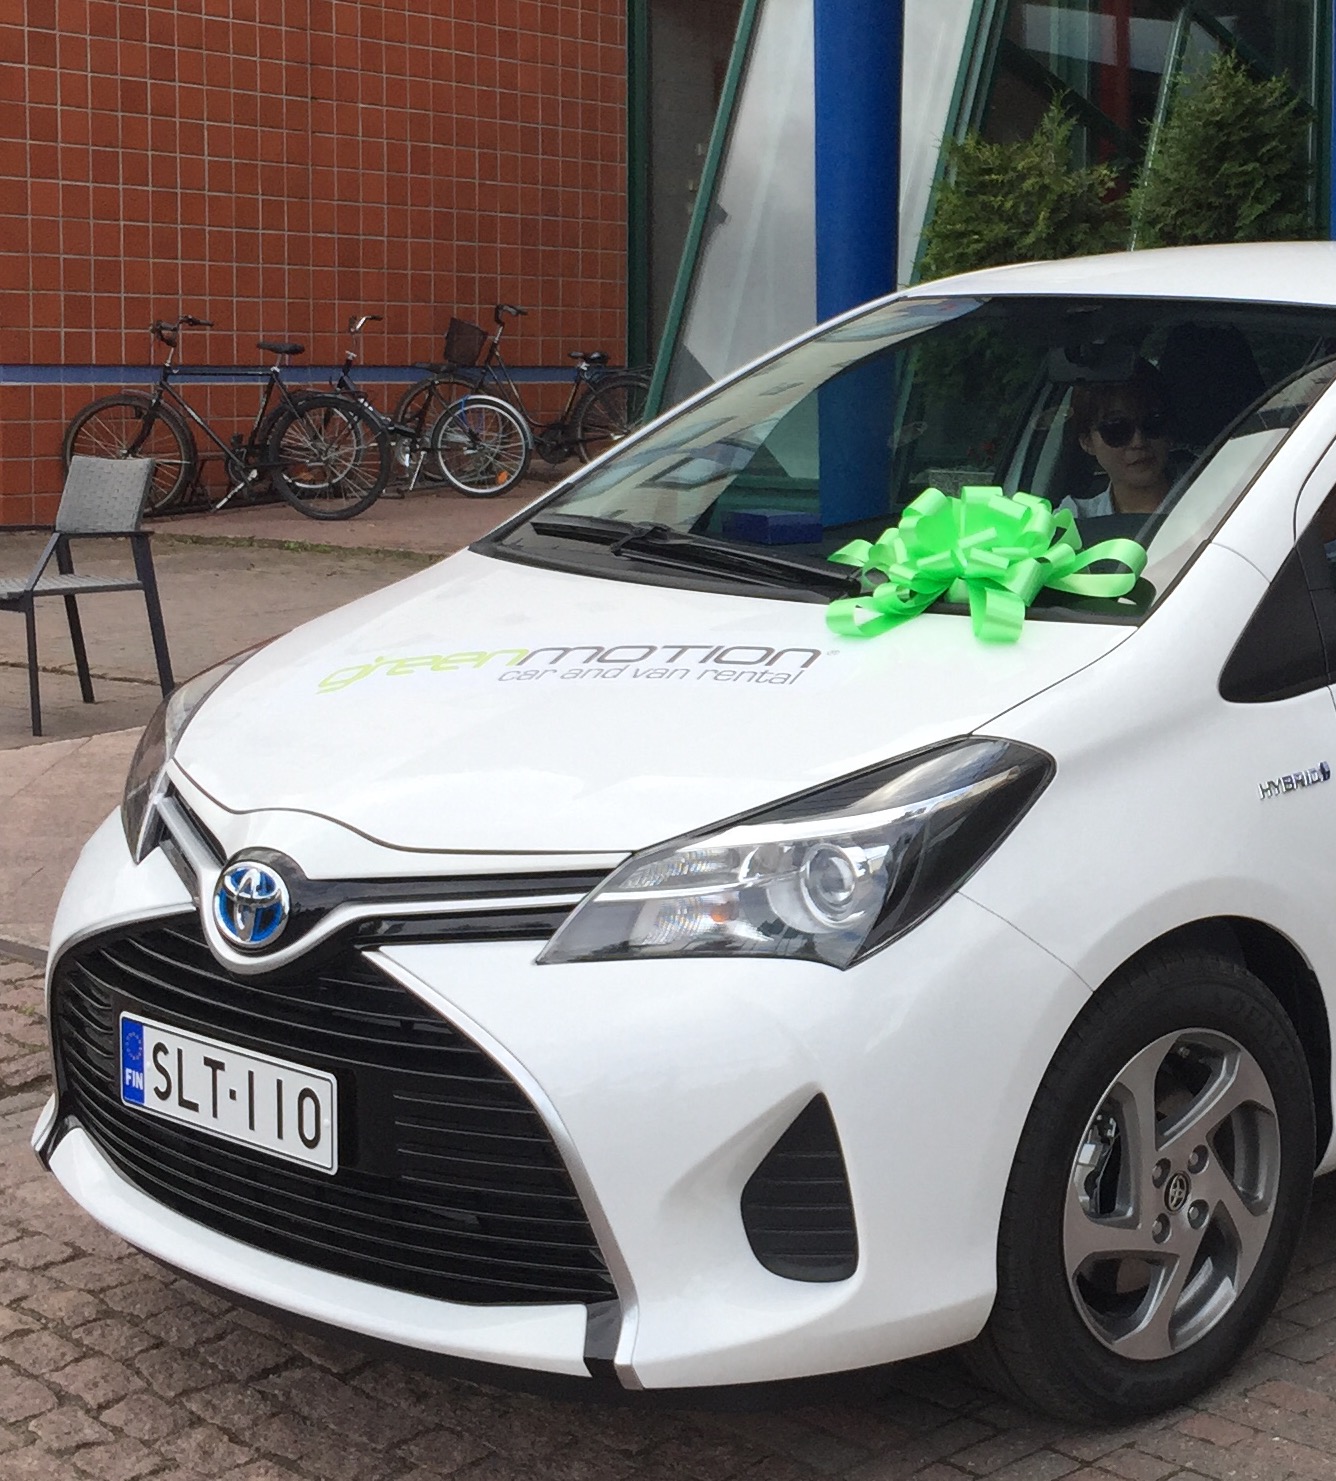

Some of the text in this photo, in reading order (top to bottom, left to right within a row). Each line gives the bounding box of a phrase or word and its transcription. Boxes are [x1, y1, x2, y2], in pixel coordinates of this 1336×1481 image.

[498, 664, 806, 685] car and van rental
[1258, 767, 1321, 800] HYBRID
[125, 1068, 144, 1091] FIN
[152, 1041, 321, 1150] SLT-110
